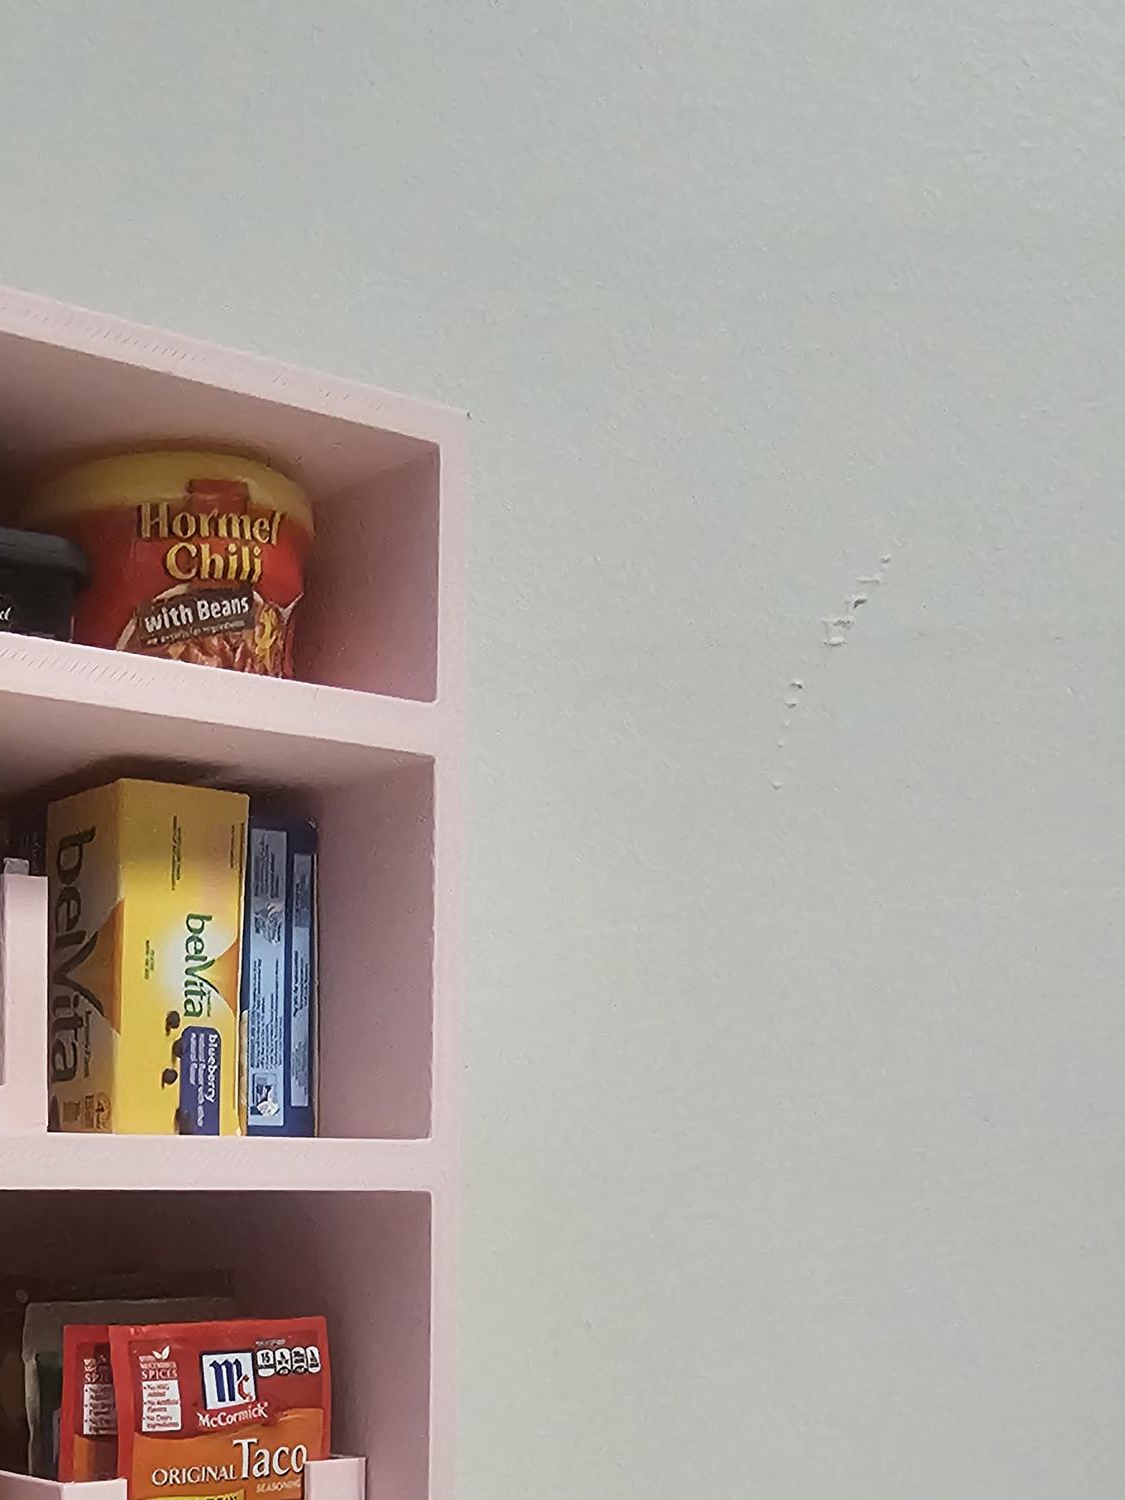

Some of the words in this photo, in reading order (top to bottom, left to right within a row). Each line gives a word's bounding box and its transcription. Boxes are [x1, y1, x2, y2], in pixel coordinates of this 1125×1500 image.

[140, 502, 282, 546] Hormel
[166, 542, 263, 583] Chili
[144, 603, 193, 633] with
[196, 596, 250, 622] Beans
[51, 826, 105, 1083] belVita
[183, 912, 219, 1018] belVita
[204, 1033, 218, 1103] blueberry
[196, 1402, 269, 1429] McCormick
[151, 1464, 238, 1487] ORIGINAL
[232, 1437, 308, 1480] Taco
